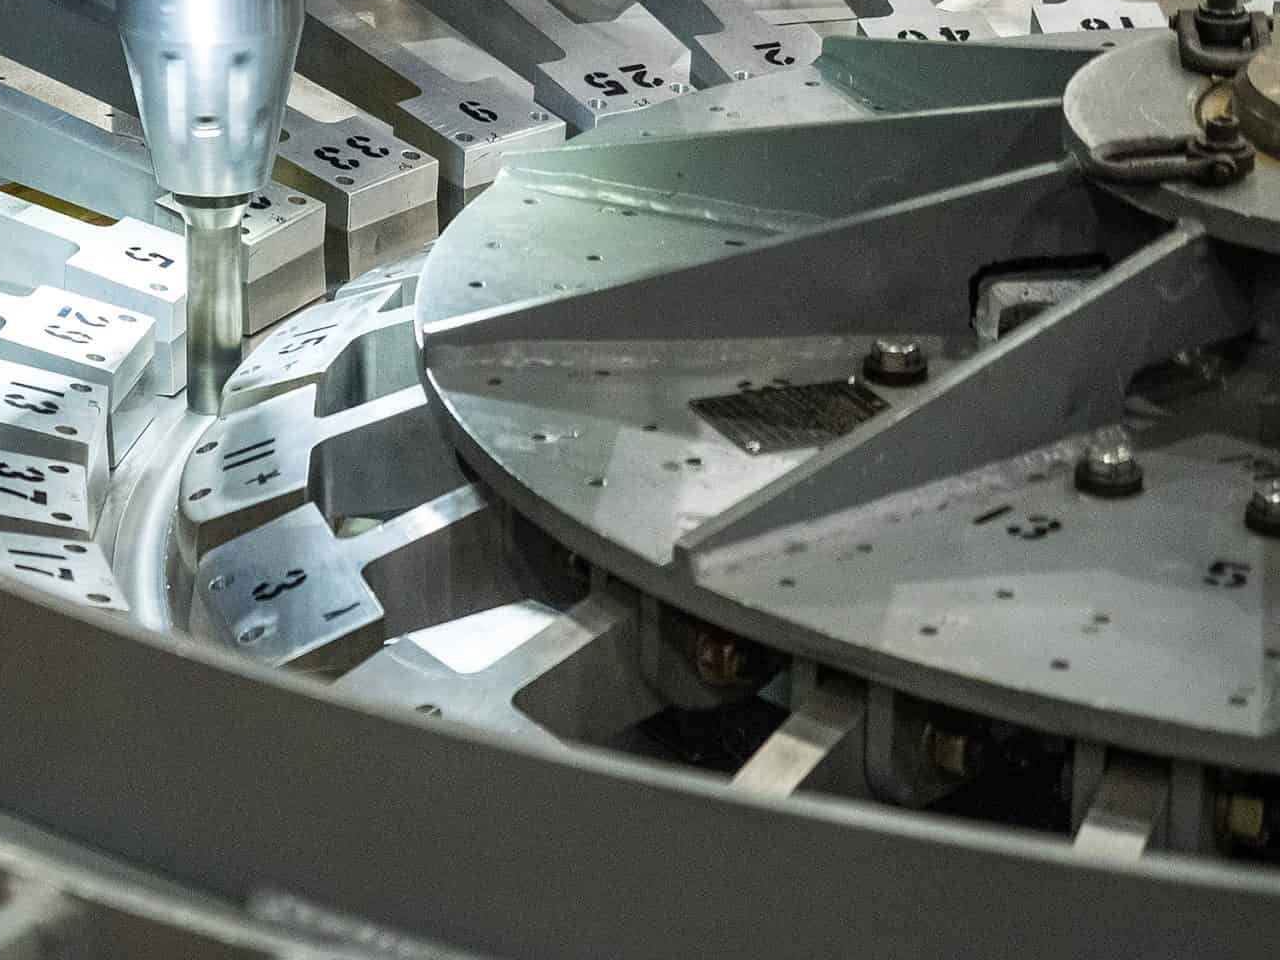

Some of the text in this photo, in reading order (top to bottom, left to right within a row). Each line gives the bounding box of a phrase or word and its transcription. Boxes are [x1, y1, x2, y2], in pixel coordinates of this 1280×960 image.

[584, 63, 665, 97] 25
[313, 135, 390, 170] 33
[124, 246, 175, 269] 5
[3, 381, 65, 415] 13
[7, 549, 75, 582] 17
